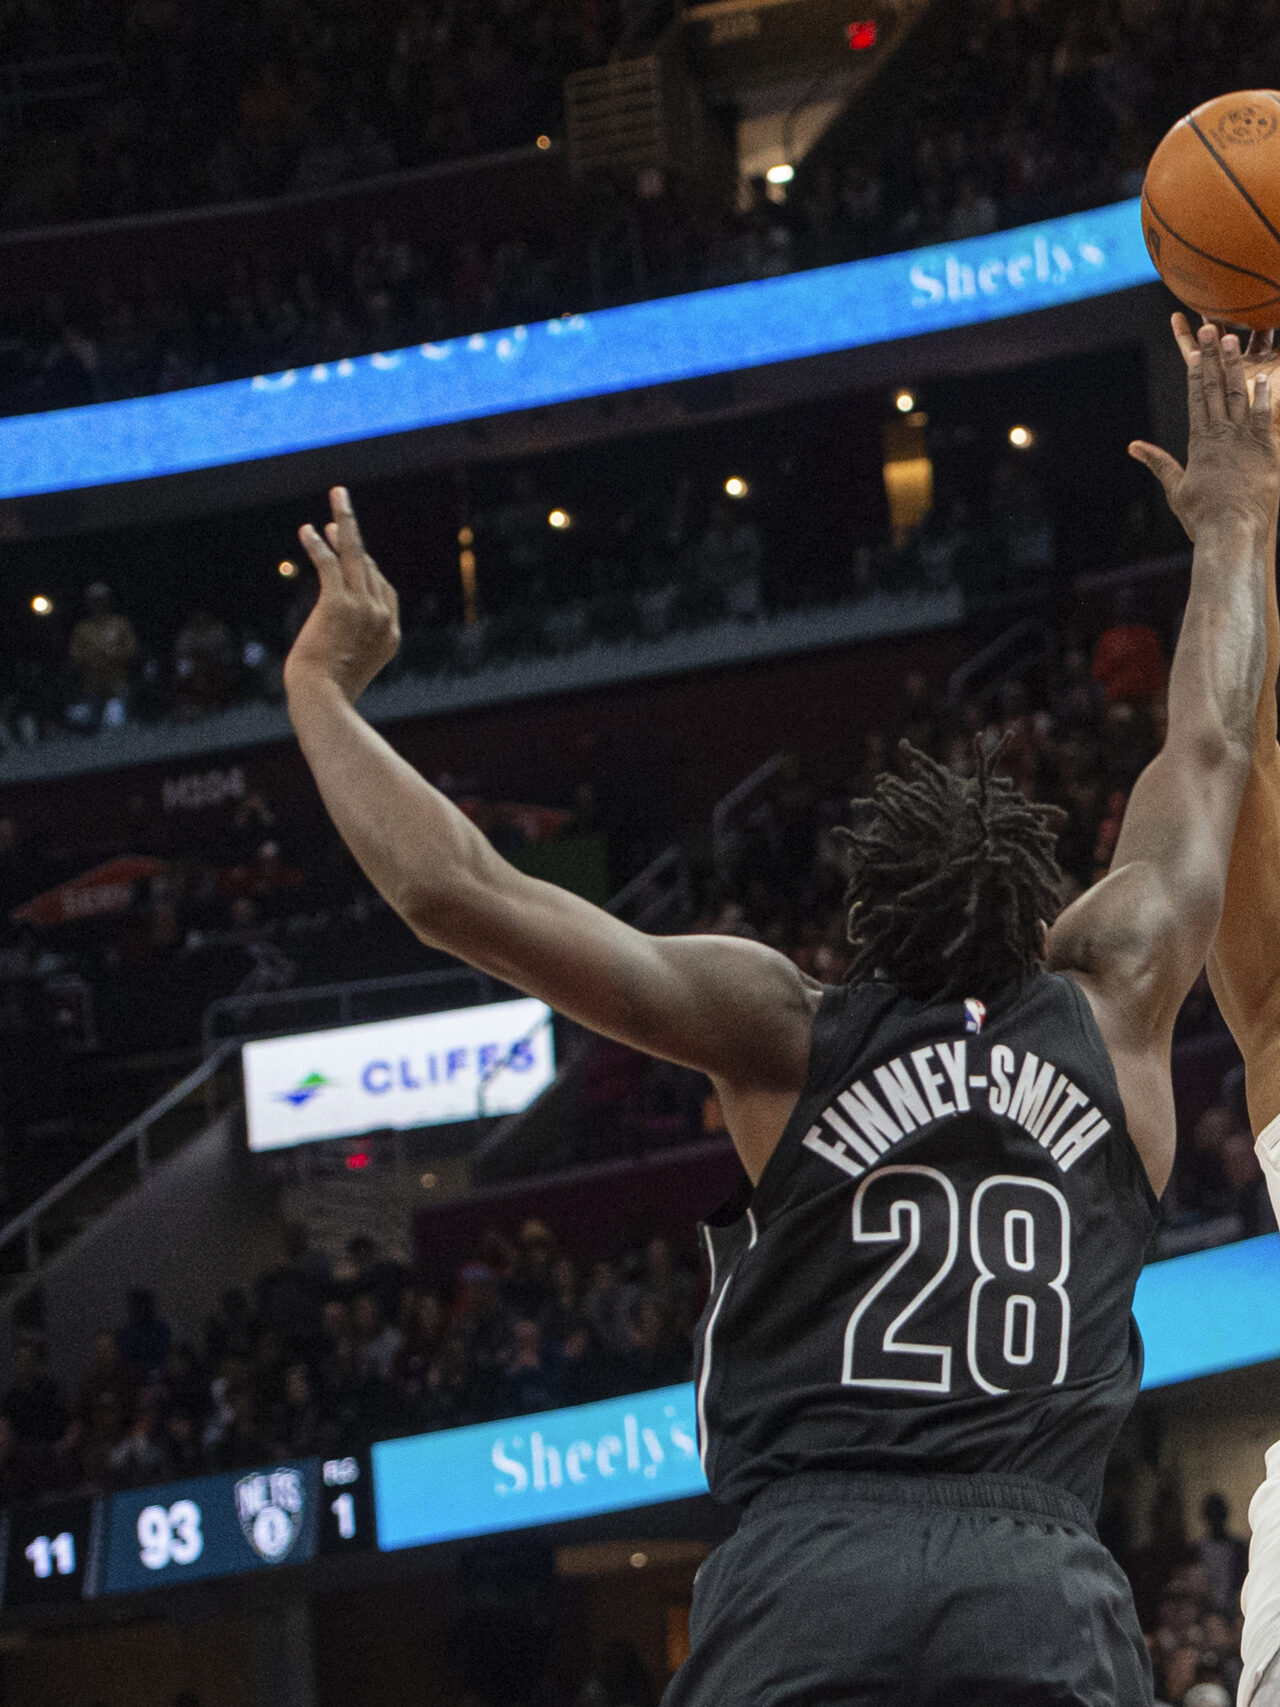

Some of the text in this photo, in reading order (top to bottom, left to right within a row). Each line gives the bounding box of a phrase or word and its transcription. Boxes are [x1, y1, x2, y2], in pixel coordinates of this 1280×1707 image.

[361, 1038, 536, 1095] CLIFFS
[801, 1039, 1112, 1178] FINNEY-SMITH
[840, 1163, 1071, 1396] 28
[136, 1499, 205, 1570] 93
[331, 1492, 357, 1541] 1
[25, 1531, 77, 1579] 11
